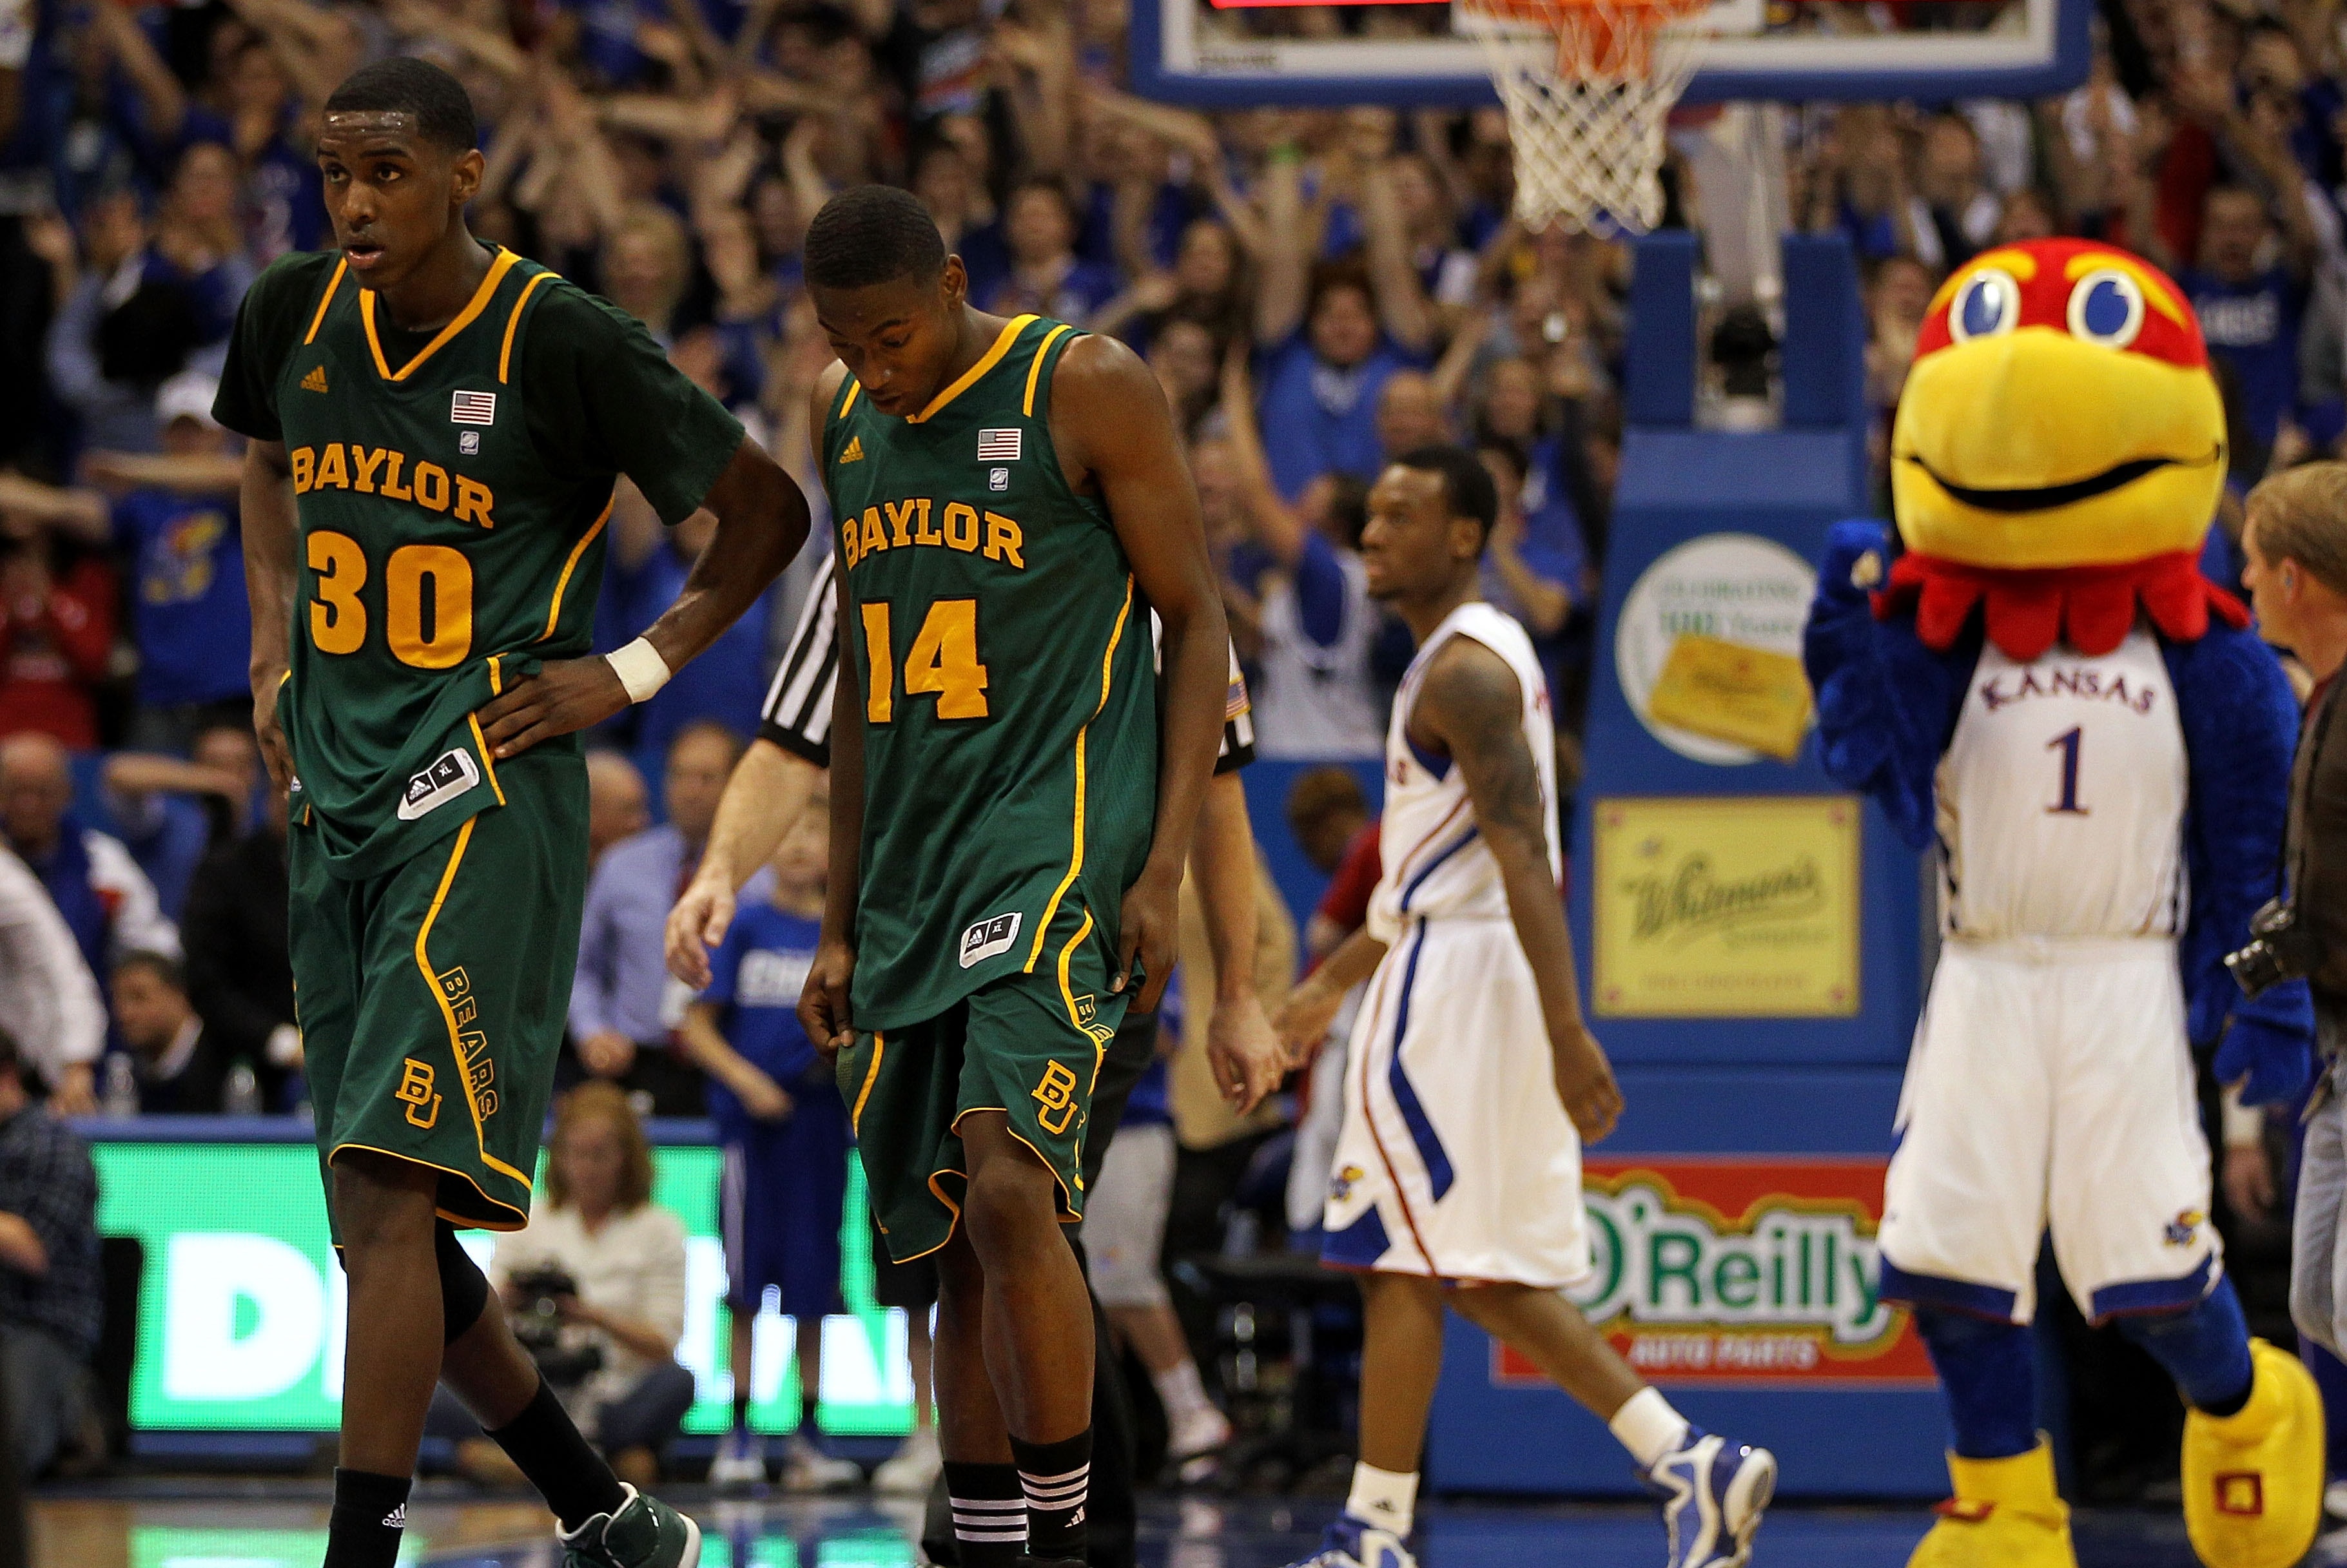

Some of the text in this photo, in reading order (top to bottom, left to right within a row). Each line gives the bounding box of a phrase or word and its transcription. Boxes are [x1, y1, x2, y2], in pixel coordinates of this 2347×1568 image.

[291, 442, 494, 528] BAYLOR
[842, 498, 1025, 569] BAYLOR
[307, 530, 473, 670] 30
[861, 599, 989, 724] 14
[1981, 666, 2156, 712] KANSAS
[2044, 722, 2092, 817] 1
[437, 965, 499, 1121] BEARS
